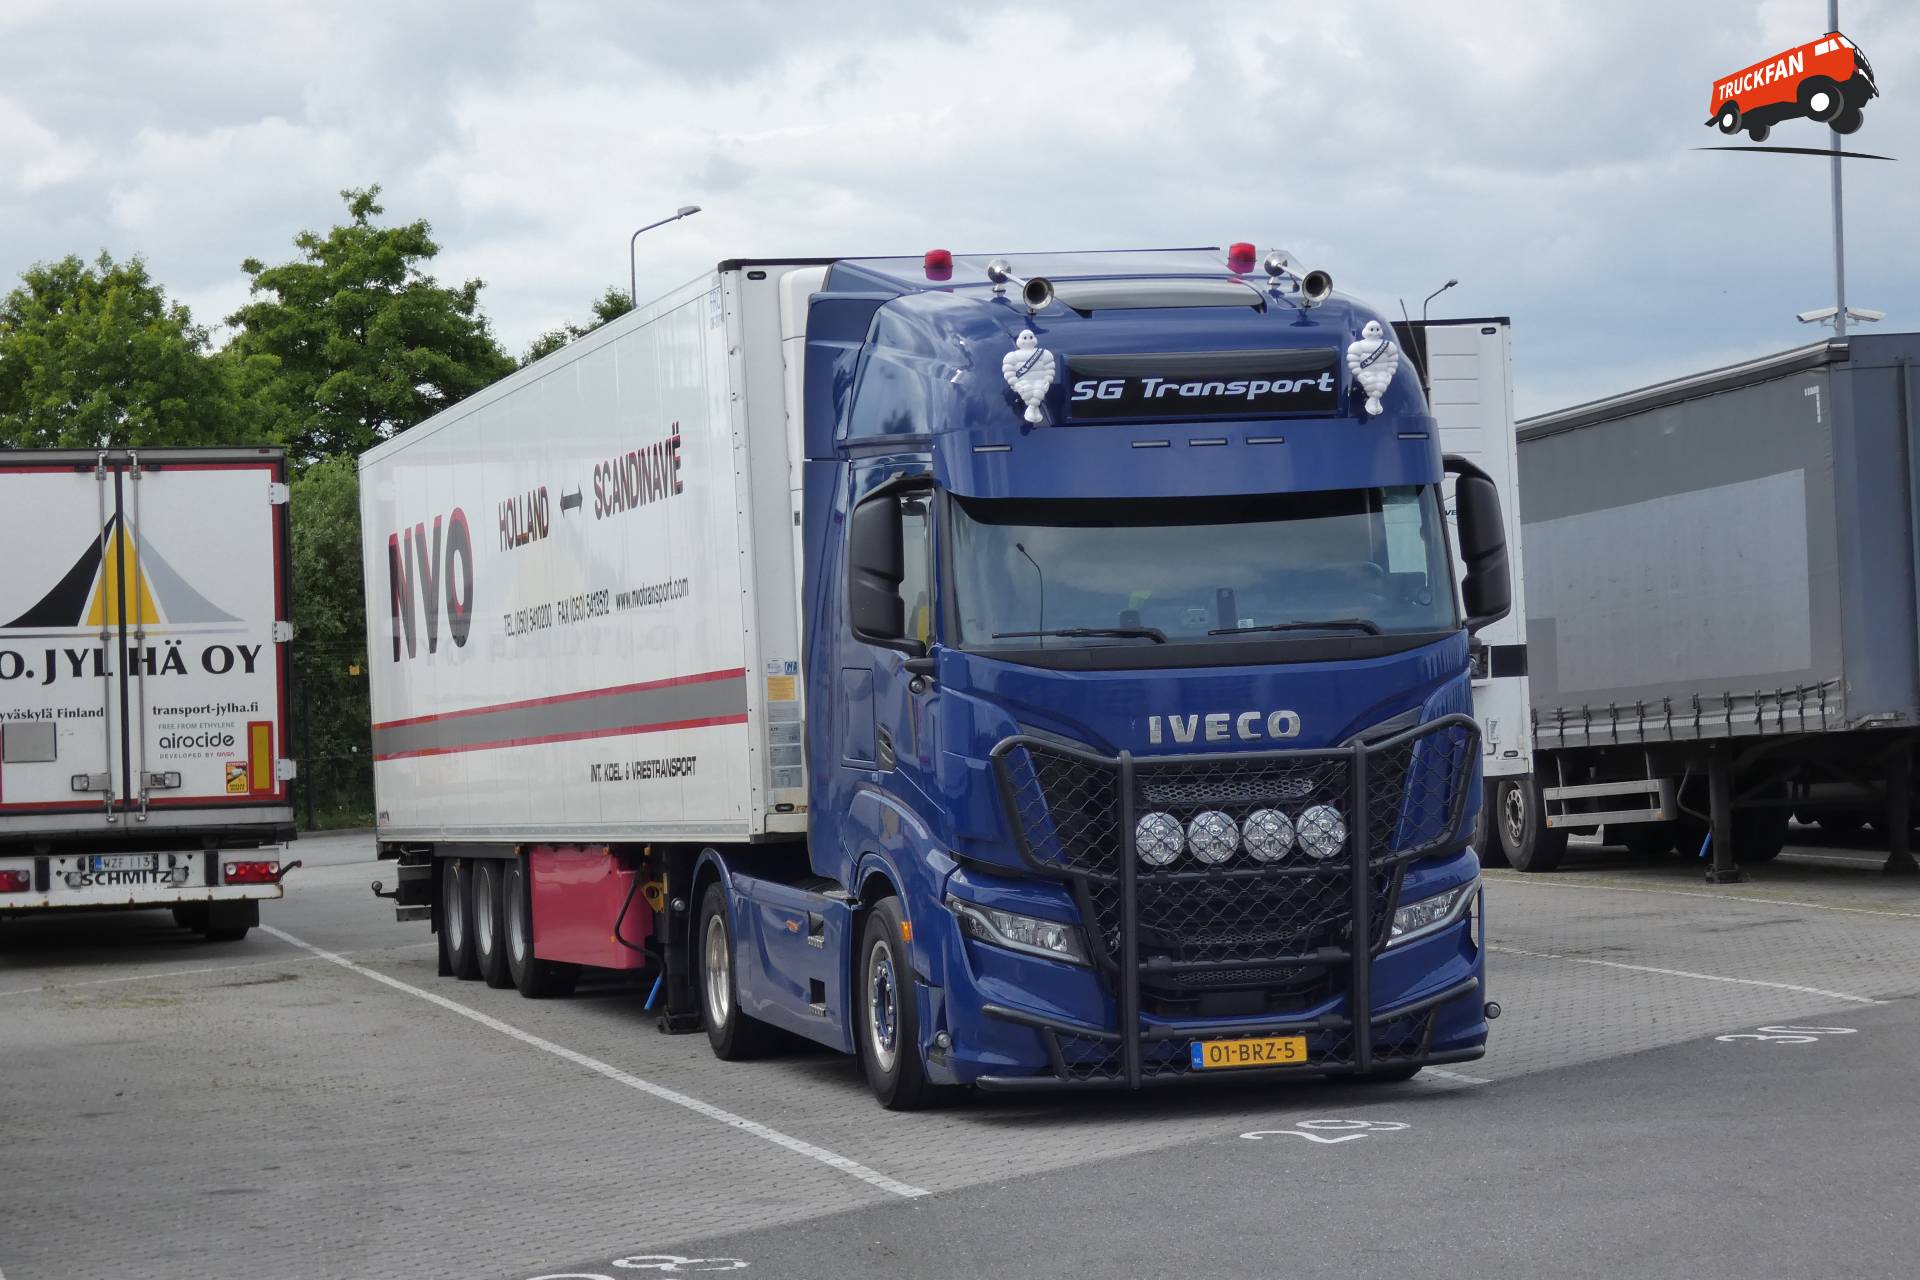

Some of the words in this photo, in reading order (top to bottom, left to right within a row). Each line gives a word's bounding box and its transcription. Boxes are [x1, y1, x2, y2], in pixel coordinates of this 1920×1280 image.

[1071, 379, 1126, 400] SG
[1141, 372, 1335, 400] Transport
[498, 486, 549, 552] HOLLAND
[593, 421, 683, 520] SCANDINAVIË
[388, 507, 474, 662] NVO
[558, 599, 569, 625] FAX
[201, 645, 262, 675] OY
[57, 707, 104, 718] Finland
[152, 701, 259, 717] transport-jylha.fi
[199, 721, 236, 729] ETHYLENE
[1149, 710, 1300, 744] IVECO
[159, 731, 235, 749] airocide
[81, 869, 172, 887] SCHMITZ
[1210, 1042, 1295, 1062] 01-BRZ-5
